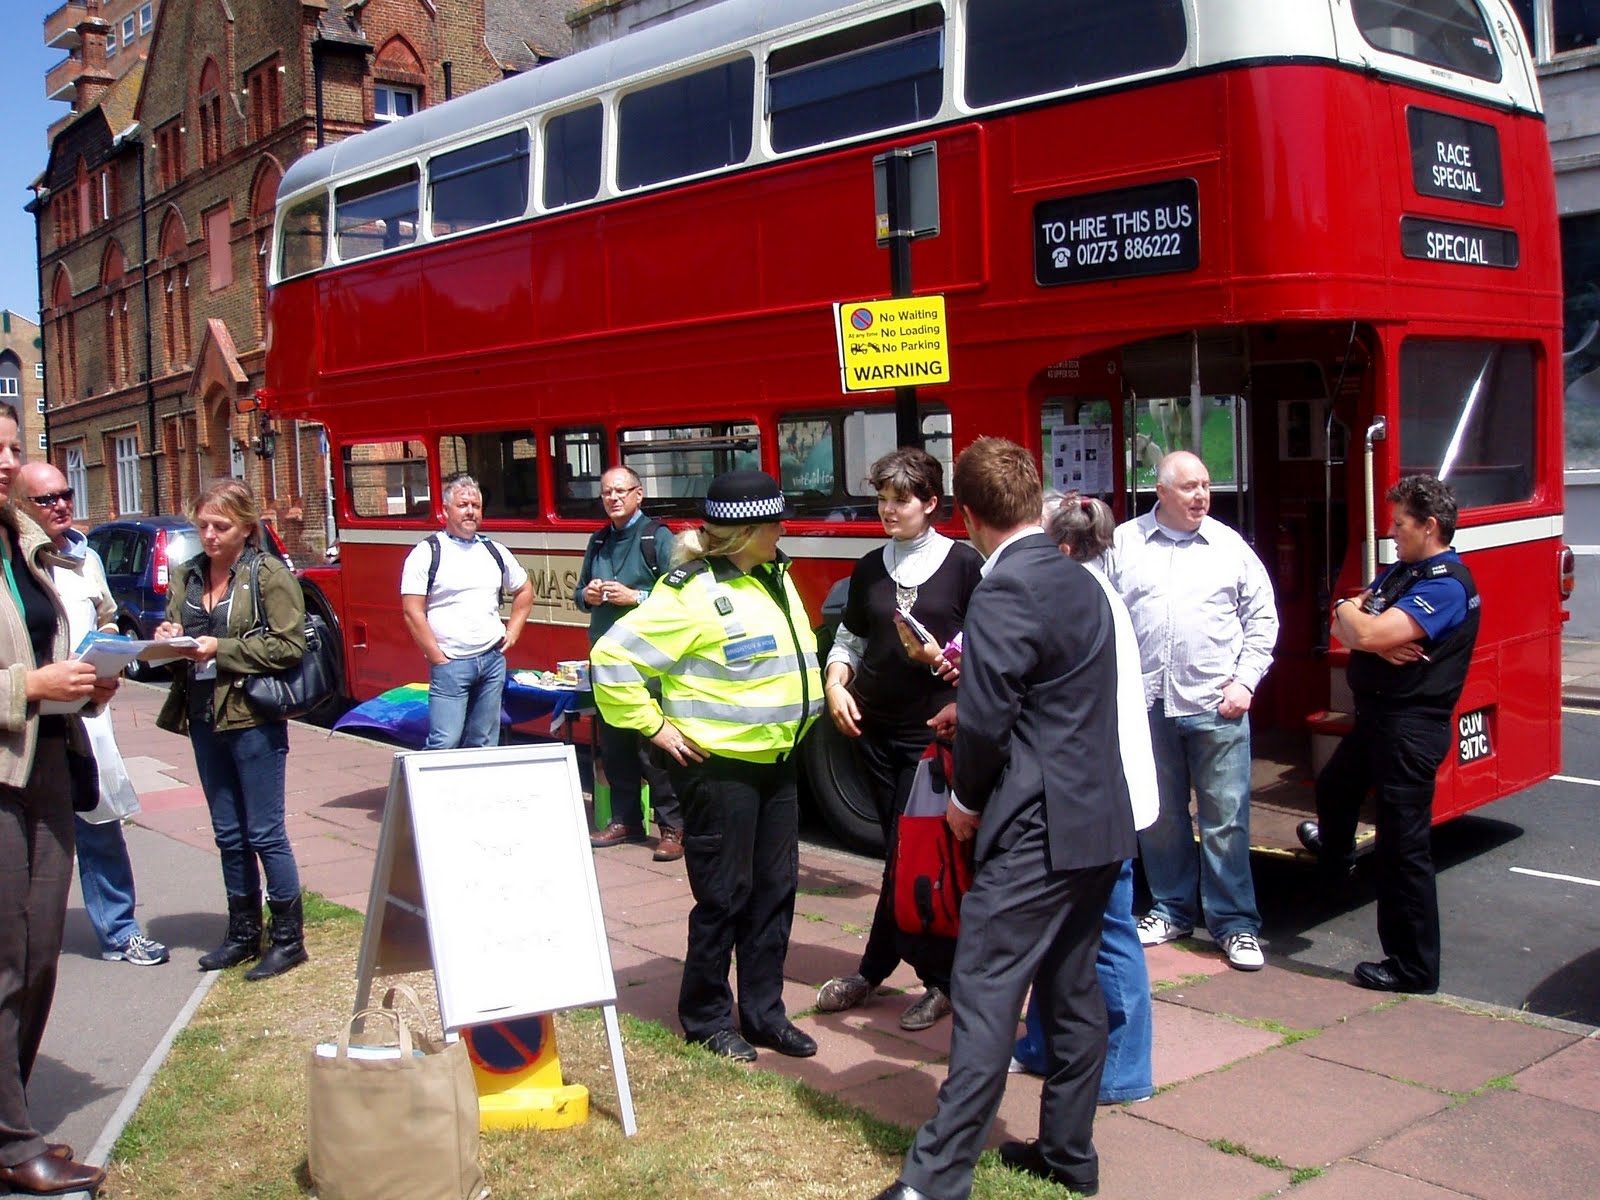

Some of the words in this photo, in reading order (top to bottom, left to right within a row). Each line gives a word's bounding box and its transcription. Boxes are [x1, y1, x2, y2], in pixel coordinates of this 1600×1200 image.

[1436, 141, 1471, 167] RACE
[1432, 165, 1481, 192] SPECIAL
[1042, 222, 1066, 244] TO
[1070, 216, 1107, 241] HIRE
[1112, 210, 1150, 235] THIS
[1155, 204, 1192, 231] BUS
[1077, 240, 1118, 266] 01273
[1124, 233, 1181, 261] 886222
[1426, 231, 1488, 265] SPECIAL
[879, 313, 895, 322] No
[898, 310, 938, 320] Waiting
[881, 328, 896, 337] No
[900, 325, 940, 336] Loading
[882, 343, 897, 352] No
[901, 340, 940, 351] Parking
[854, 360, 942, 381] WARNING
[1459, 712, 1482, 736] CUV
[1460, 734, 1488, 760] 317C
